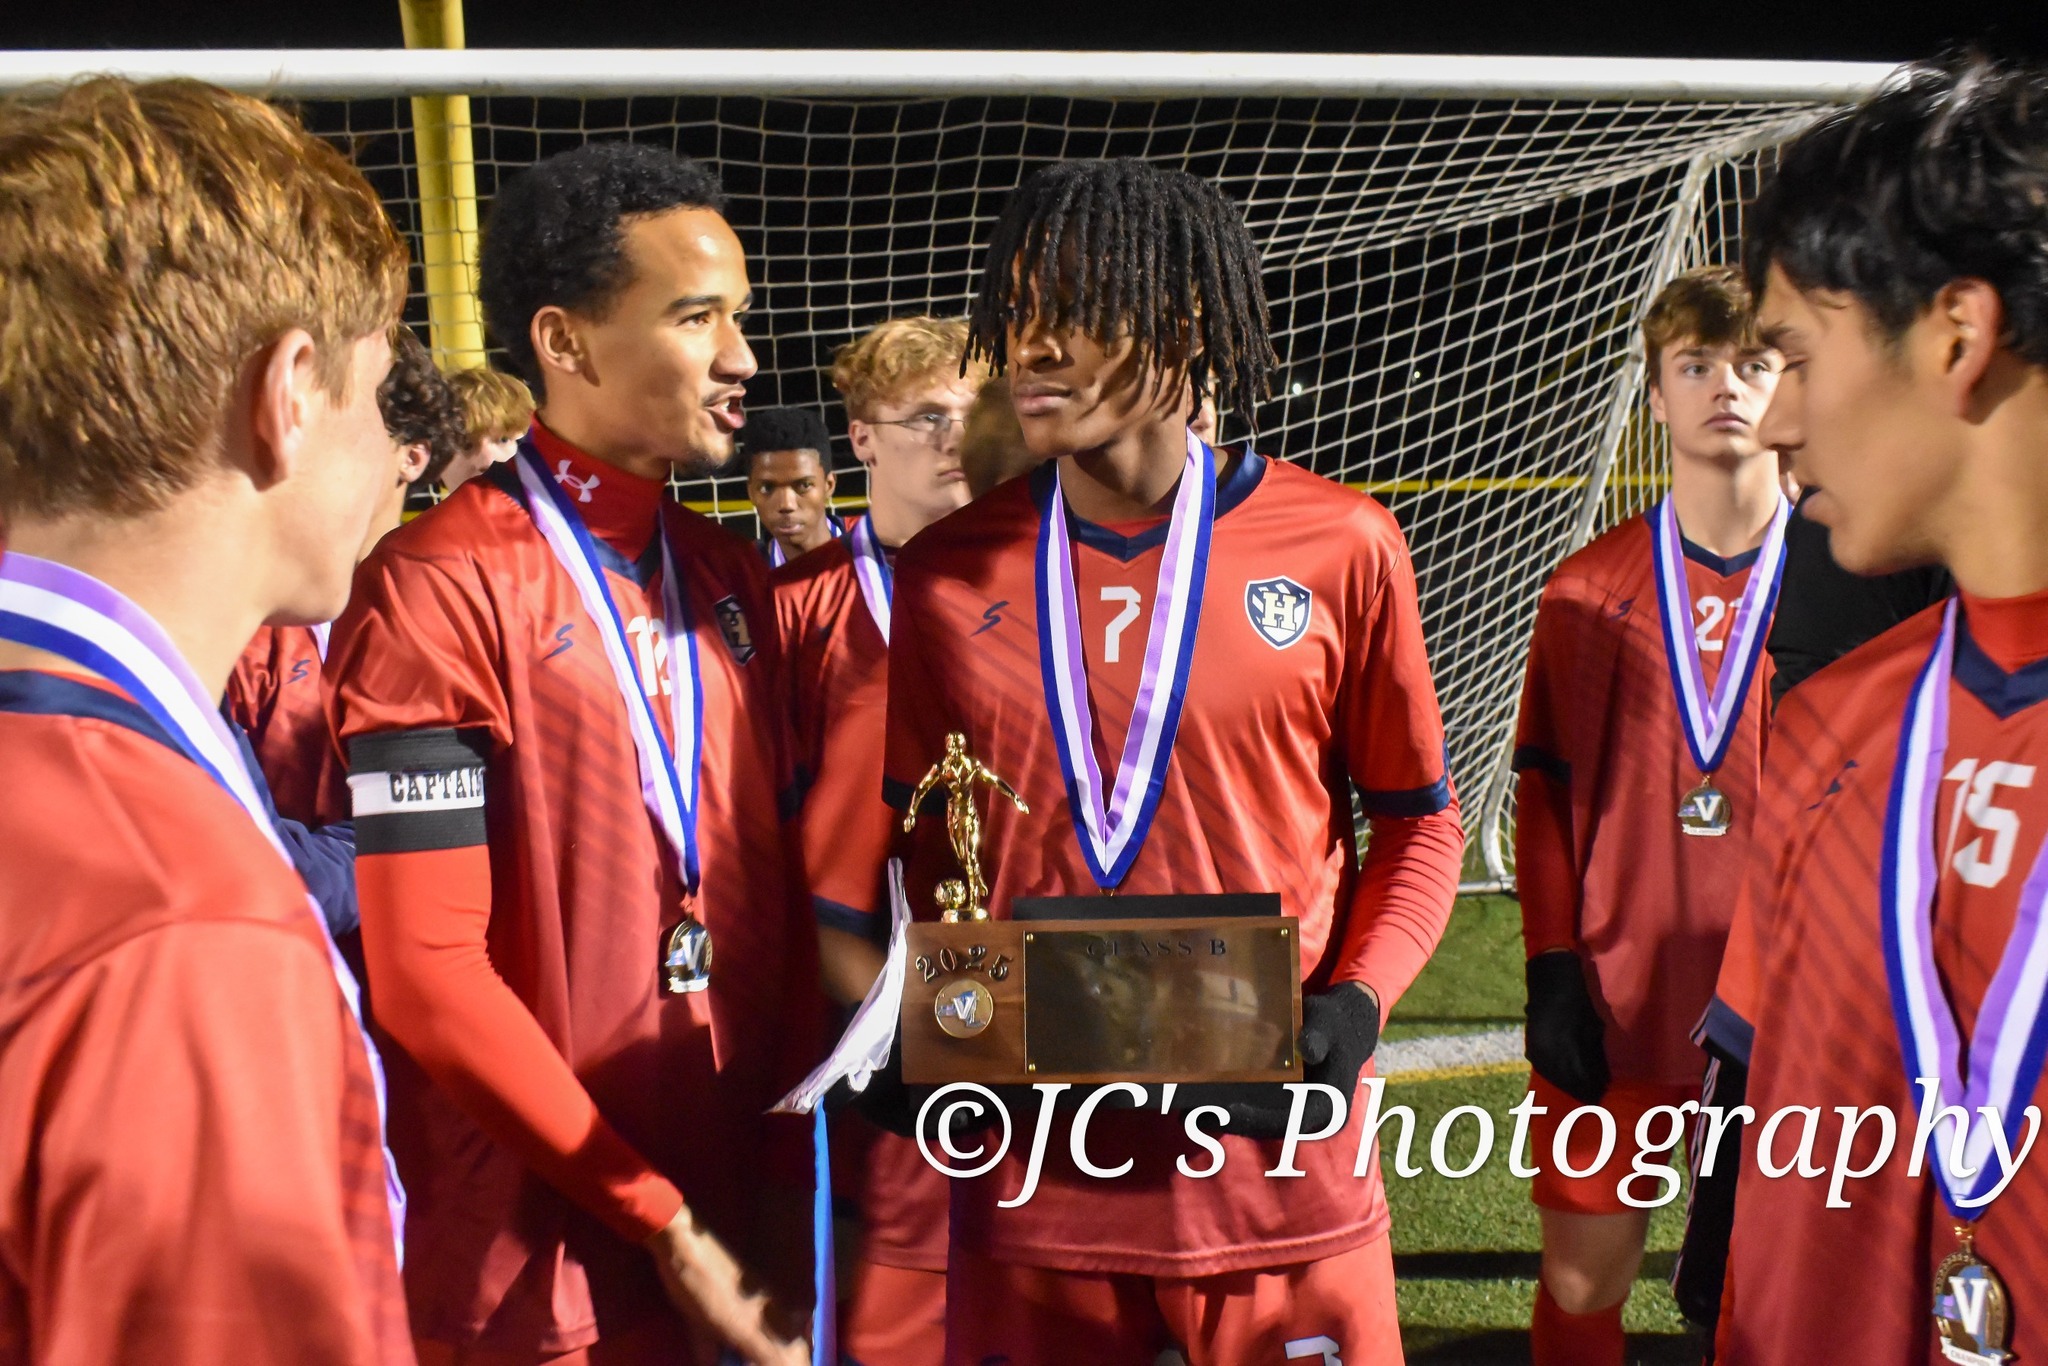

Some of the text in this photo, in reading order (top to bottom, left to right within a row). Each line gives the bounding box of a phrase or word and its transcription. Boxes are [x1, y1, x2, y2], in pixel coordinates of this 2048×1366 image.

[1101, 586, 1142, 663] 7
[1261, 590, 1298, 632] H
[1696, 596, 1743, 651] 2
[1692, 795, 1723, 821] V
[1942, 758, 2038, 889] 15
[680, 930, 708, 971] V
[915, 946, 1013, 983] 2025
[1086, 938, 1227, 957] CLASS B
[952, 995, 977, 1020] V
[1947, 1276, 1990, 1335] V
